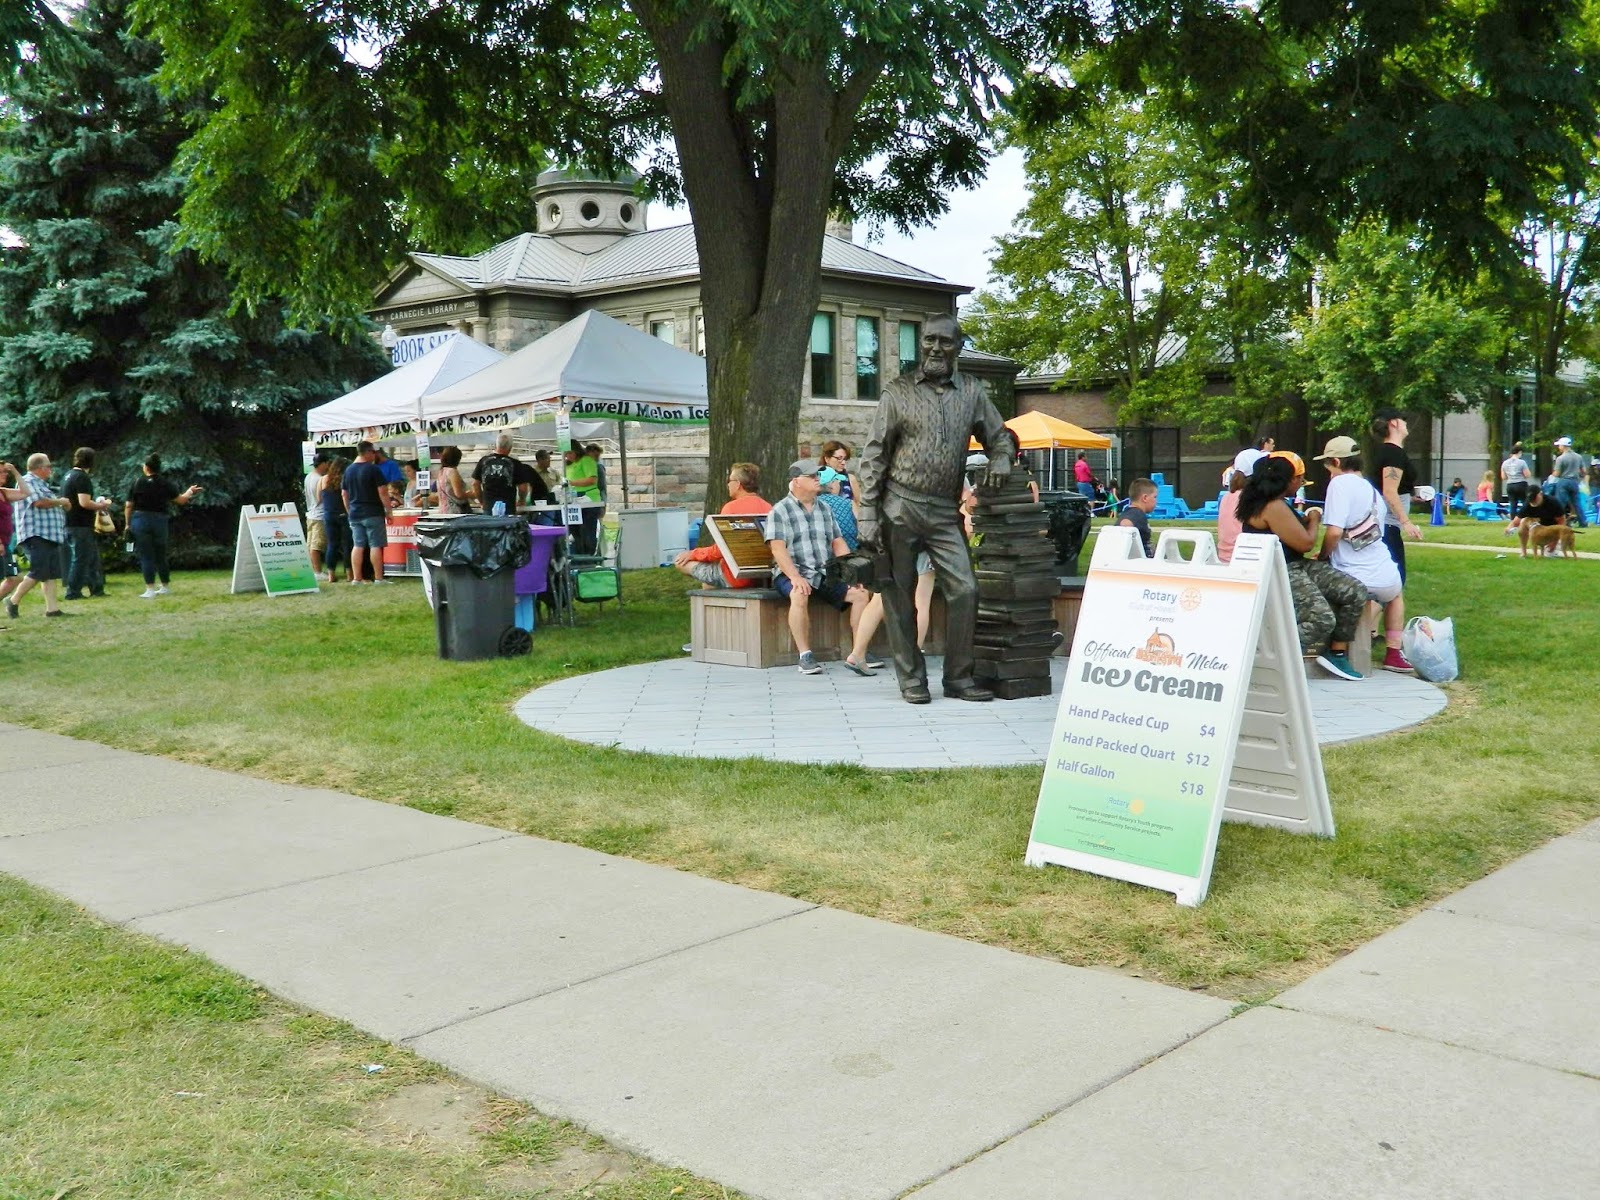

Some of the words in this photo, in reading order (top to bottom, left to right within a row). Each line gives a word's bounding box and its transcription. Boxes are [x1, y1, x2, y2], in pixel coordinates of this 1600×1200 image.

[390, 308, 425, 321] CARNEGIE
[427, 303, 458, 315] LIBRARY
[393, 337, 424, 363] BOOK
[636, 403, 683, 420] Melon
[688, 406, 710, 420] Ice
[1142, 589, 1178, 604] Rotary
[1083, 640, 1136, 662] Official
[1186, 652, 1229, 671] Melon
[1081, 661, 1132, 688] Ice
[1134, 669, 1224, 702] Cream
[1068, 704, 1100, 720] Hand
[1101, 709, 1144, 727] Packed
[1146, 716, 1169, 733] Cup
[1200, 724, 1216, 738] $4
[1062, 731, 1094, 747] Hand
[1095, 737, 1138, 755] Packed
[1140, 744, 1176, 761] Quart
[1186, 752, 1210, 767] $12
[1056, 758, 1080, 773] Half
[1080, 763, 1115, 780] Gallon
[1180, 780, 1204, 796] $18
[1108, 796, 1129, 808] Rotary
[1098, 818, 1124, 829] Community
[1124, 824, 1141, 832] Service
